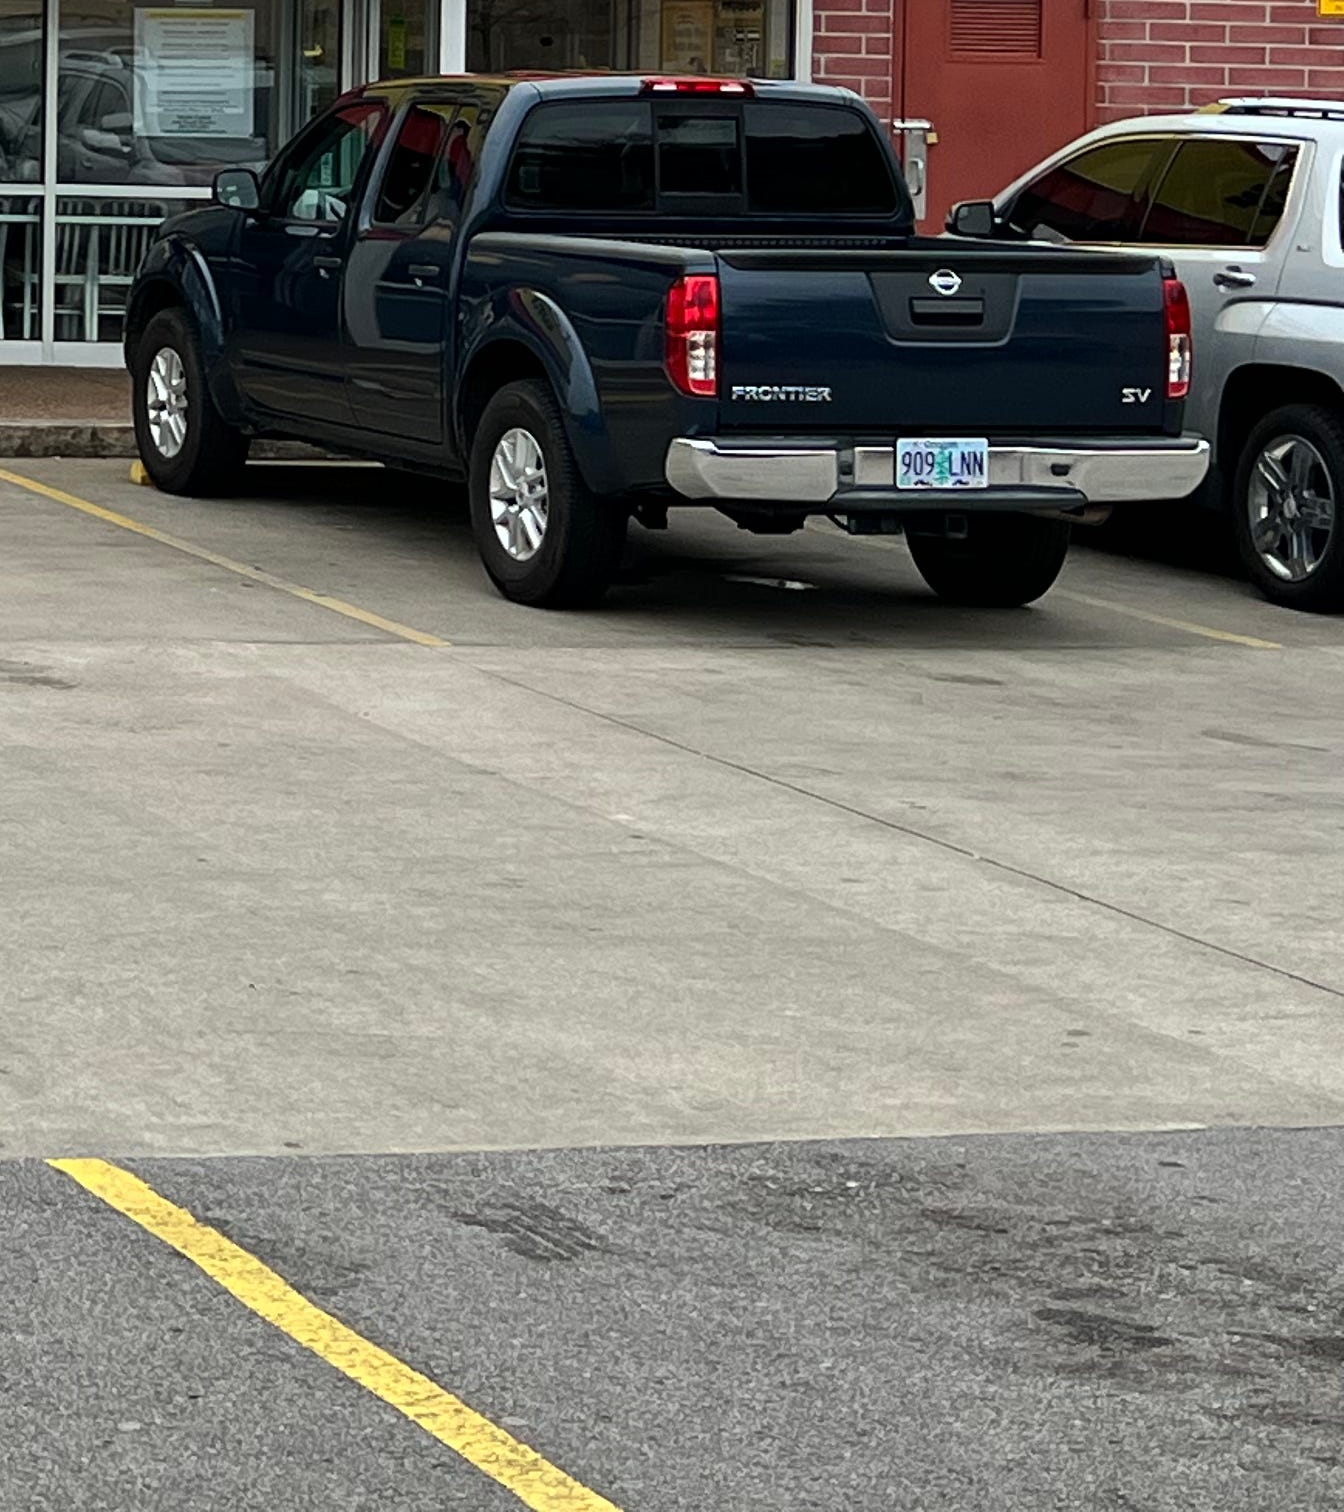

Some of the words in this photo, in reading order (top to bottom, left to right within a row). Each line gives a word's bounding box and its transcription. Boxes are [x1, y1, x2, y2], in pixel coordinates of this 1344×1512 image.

[731, 385, 832, 403] FRONTIER
[1121, 387, 1152, 404] SV
[902, 451, 935, 476] 909
[948, 451, 984, 477] LNN
